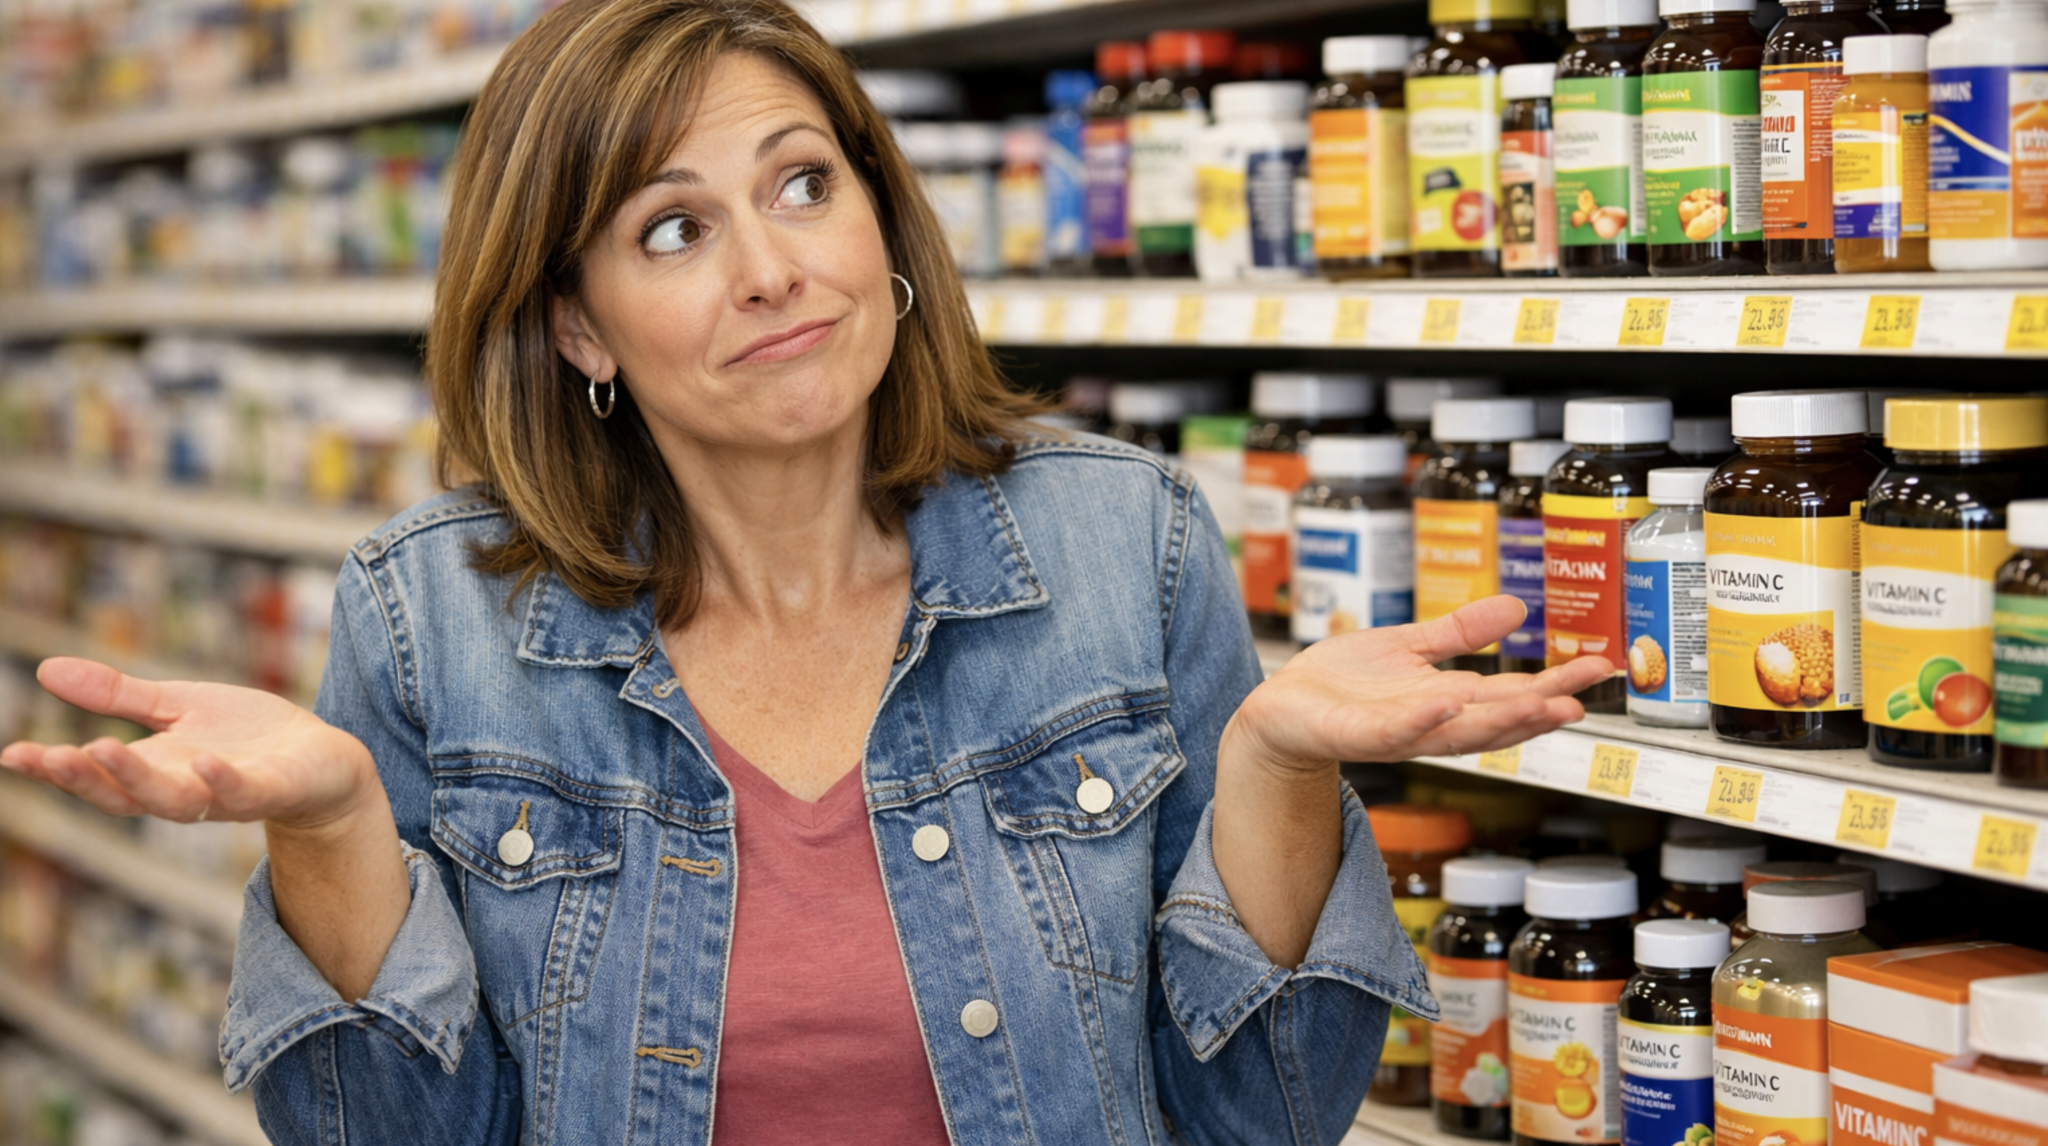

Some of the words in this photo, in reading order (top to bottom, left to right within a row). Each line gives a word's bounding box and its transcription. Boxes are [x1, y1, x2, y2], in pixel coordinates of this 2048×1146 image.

[1708, 567, 1770, 590] VITAMIN
[1772, 573, 1784, 591] C
[1865, 579, 1930, 604] VITAMIN
[1933, 586, 1947, 605] C
[1564, 1015, 1577, 1032] C
[1620, 1034, 1666, 1057] ITAMIN
[1669, 1043, 1682, 1059] C
[1714, 1059, 1767, 1088] VITAMIN
[1769, 1075, 1781, 1091] C
